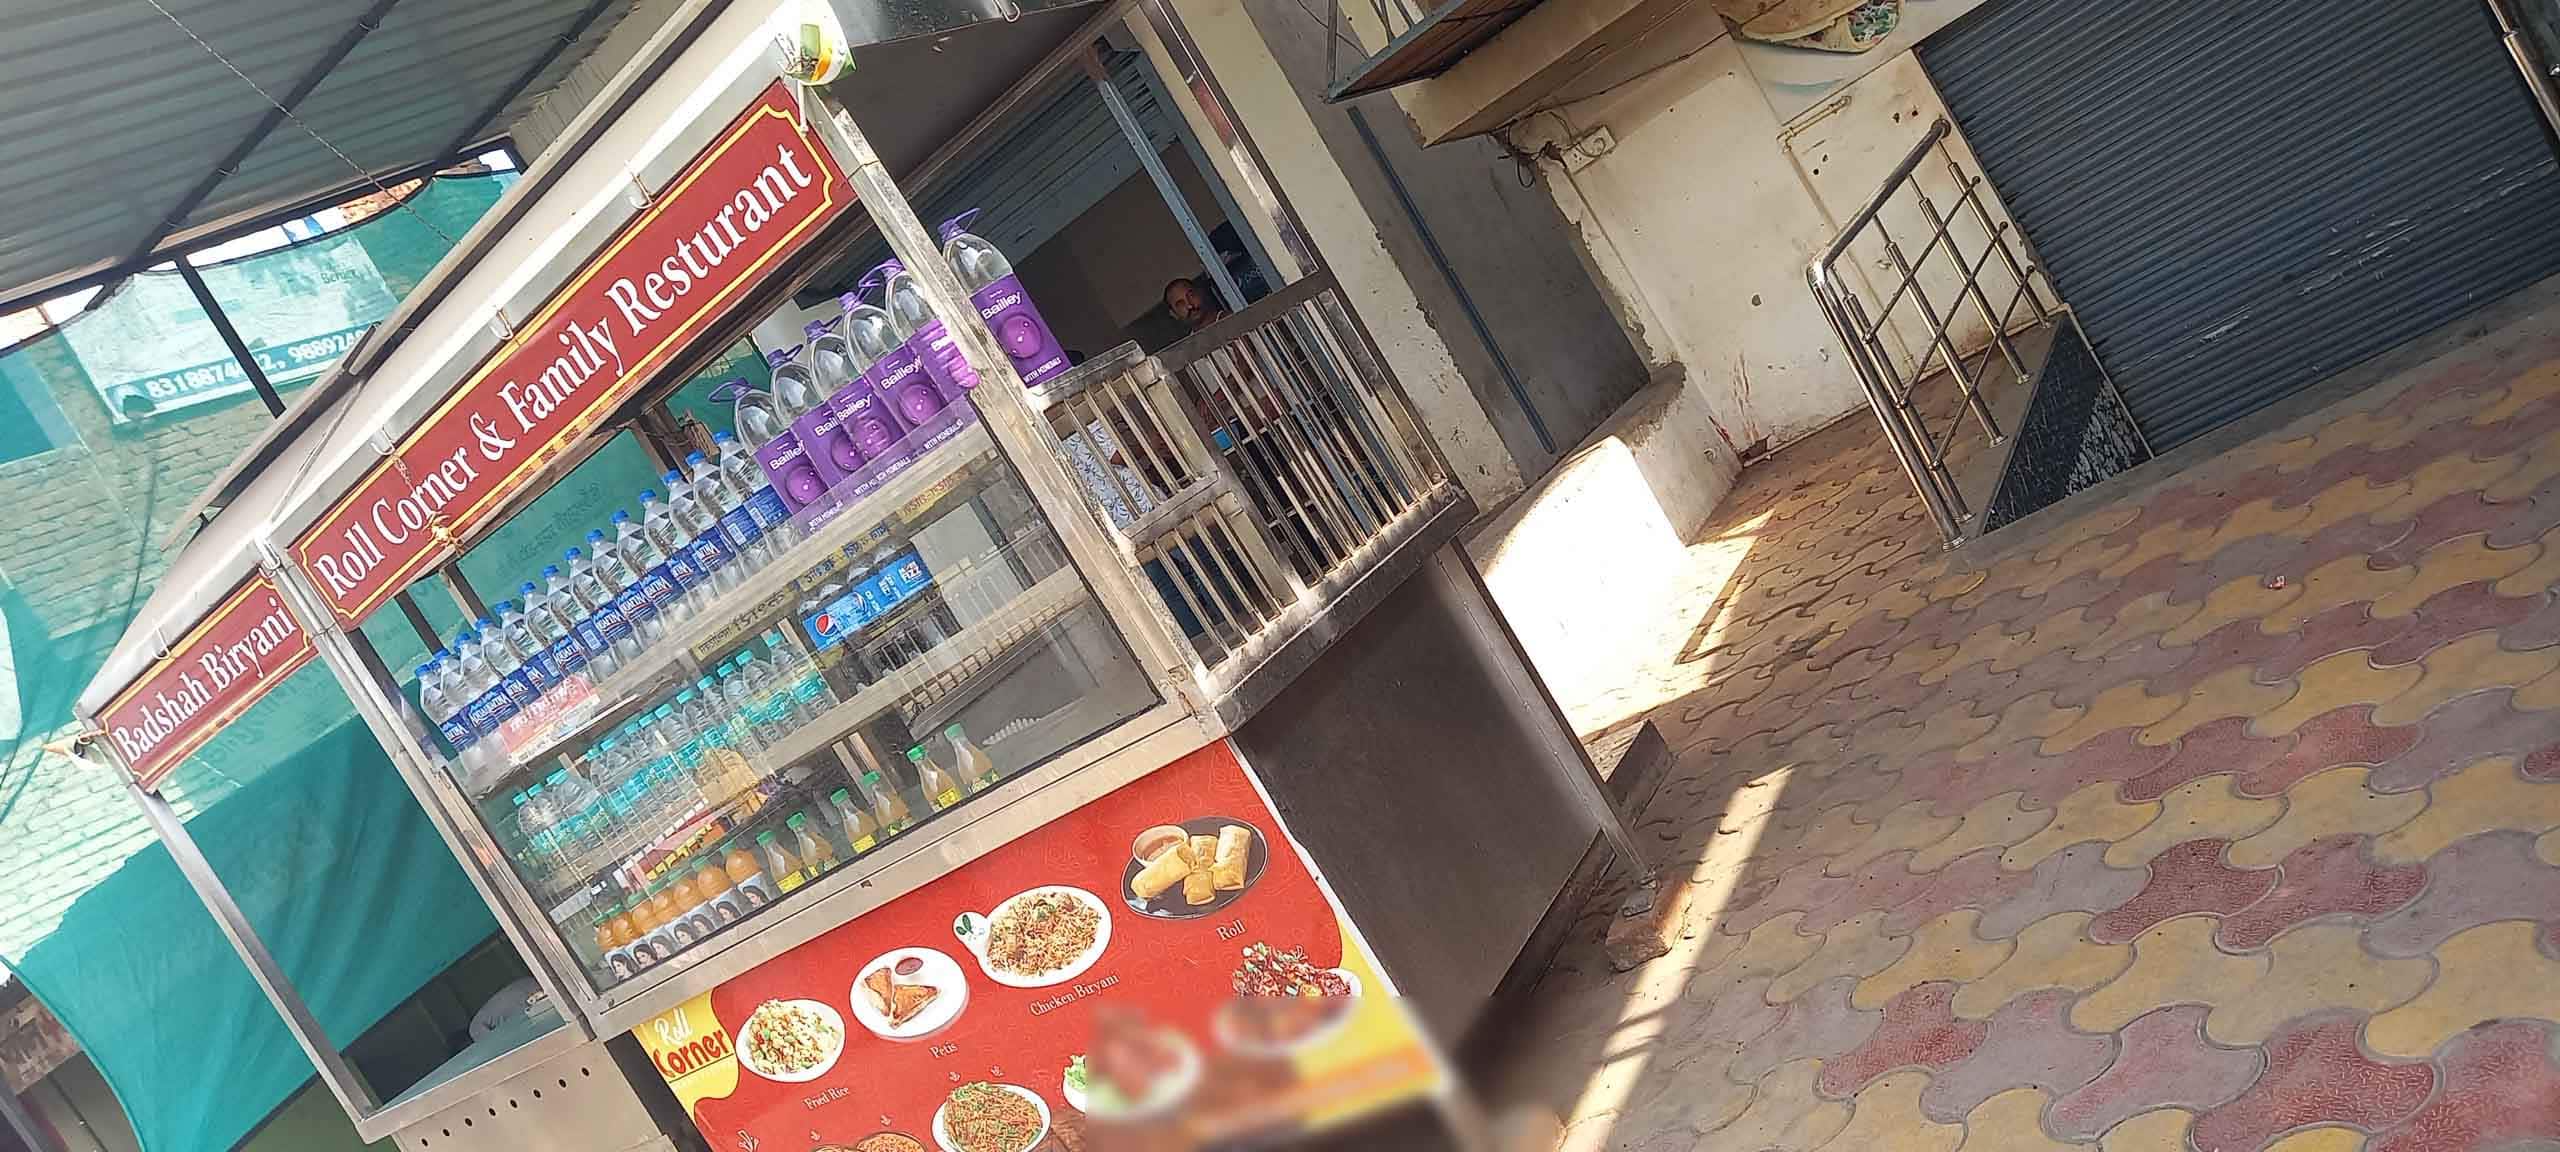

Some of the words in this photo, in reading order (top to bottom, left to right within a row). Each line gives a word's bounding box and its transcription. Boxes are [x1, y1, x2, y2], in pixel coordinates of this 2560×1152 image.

[981, 291, 1021, 320] Bailley
[146, 352, 284, 399] 83188742,
[313, 518, 383, 601] Roll
[372, 447, 481, 547] Corner
[469, 412, 516, 461] &
[497, 320, 625, 435] Family
[605, 142, 812, 337] Resturant
[814, 415, 840, 437] Bail
[111, 667, 210, 764] Badshah
[202, 598, 298, 695] Biryani
[1216, 919, 1247, 942] Roll
[1030, 989, 1074, 1017] Chicken
[1073, 972, 1119, 1000] Biryani
[653, 1007, 694, 1046] Roll
[654, 1029, 730, 1077] Corner
[930, 1041, 959, 1060] Petis
[803, 1093, 829, 1111] Fried
[829, 1085, 850, 1101] Rice
